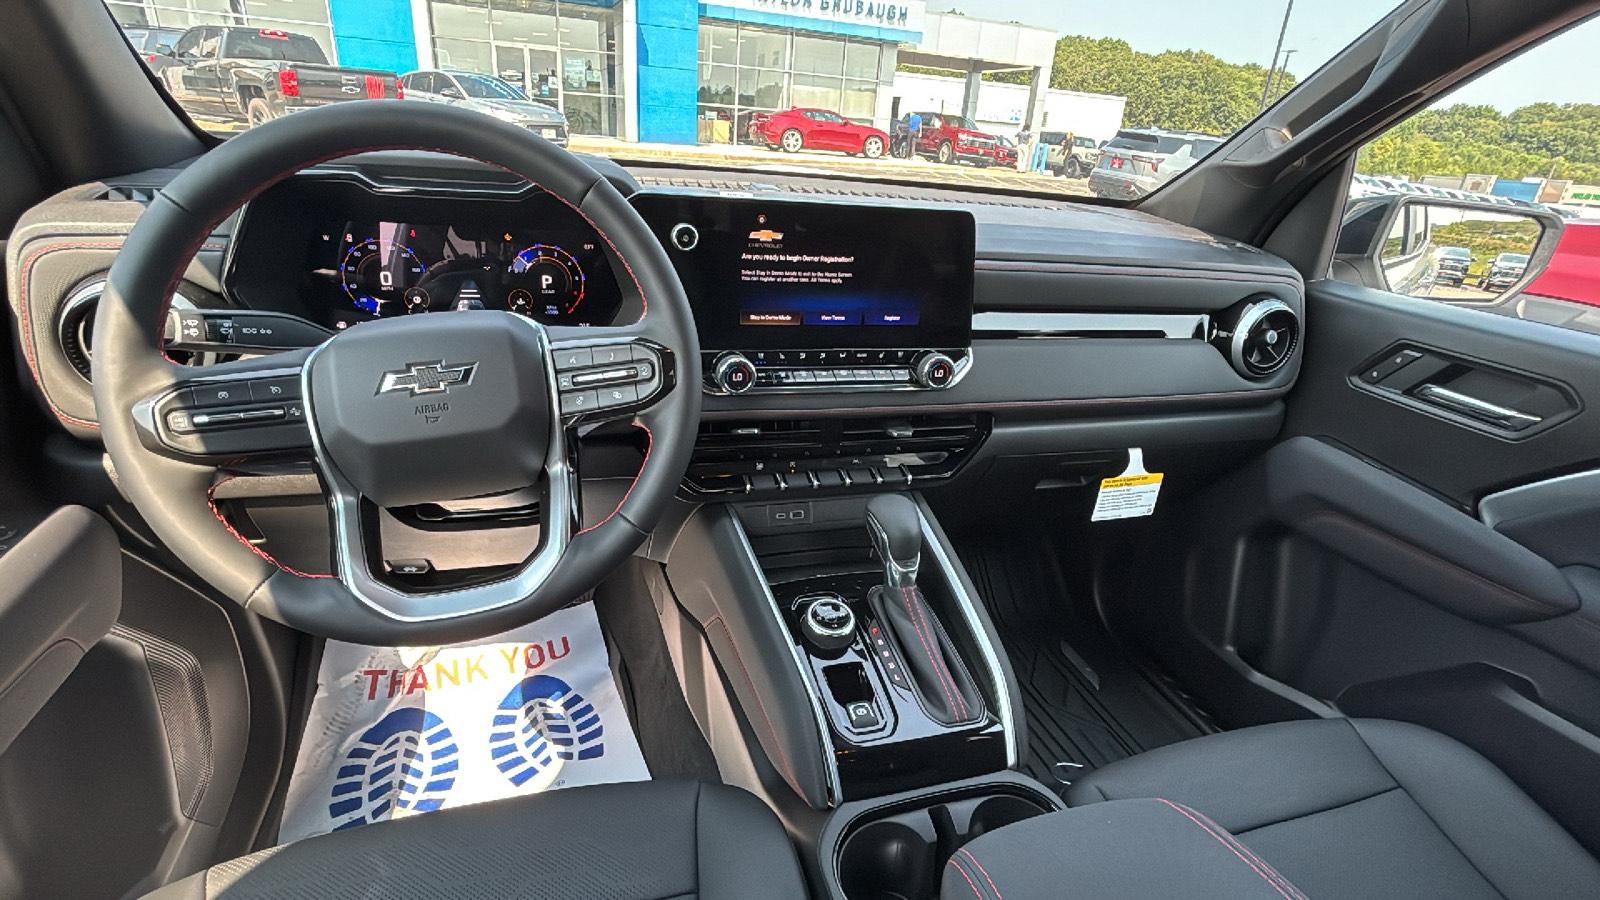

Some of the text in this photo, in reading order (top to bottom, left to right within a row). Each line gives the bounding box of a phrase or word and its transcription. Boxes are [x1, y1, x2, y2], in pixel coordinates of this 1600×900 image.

[820, 0, 908, 22] GRUBAUGH
[763, 254, 779, 262] ready
[786, 254, 802, 262] begin
[802, 254, 820, 262] Owner
[820, 255, 854, 264] Registration?
[379, 271, 393, 286] 0
[541, 275, 553, 290] P
[732, 373, 743, 381] LO
[934, 370, 945, 378] LO
[414, 402, 449, 415] AIRBAG
[363, 636, 572, 701] THANK YOU
